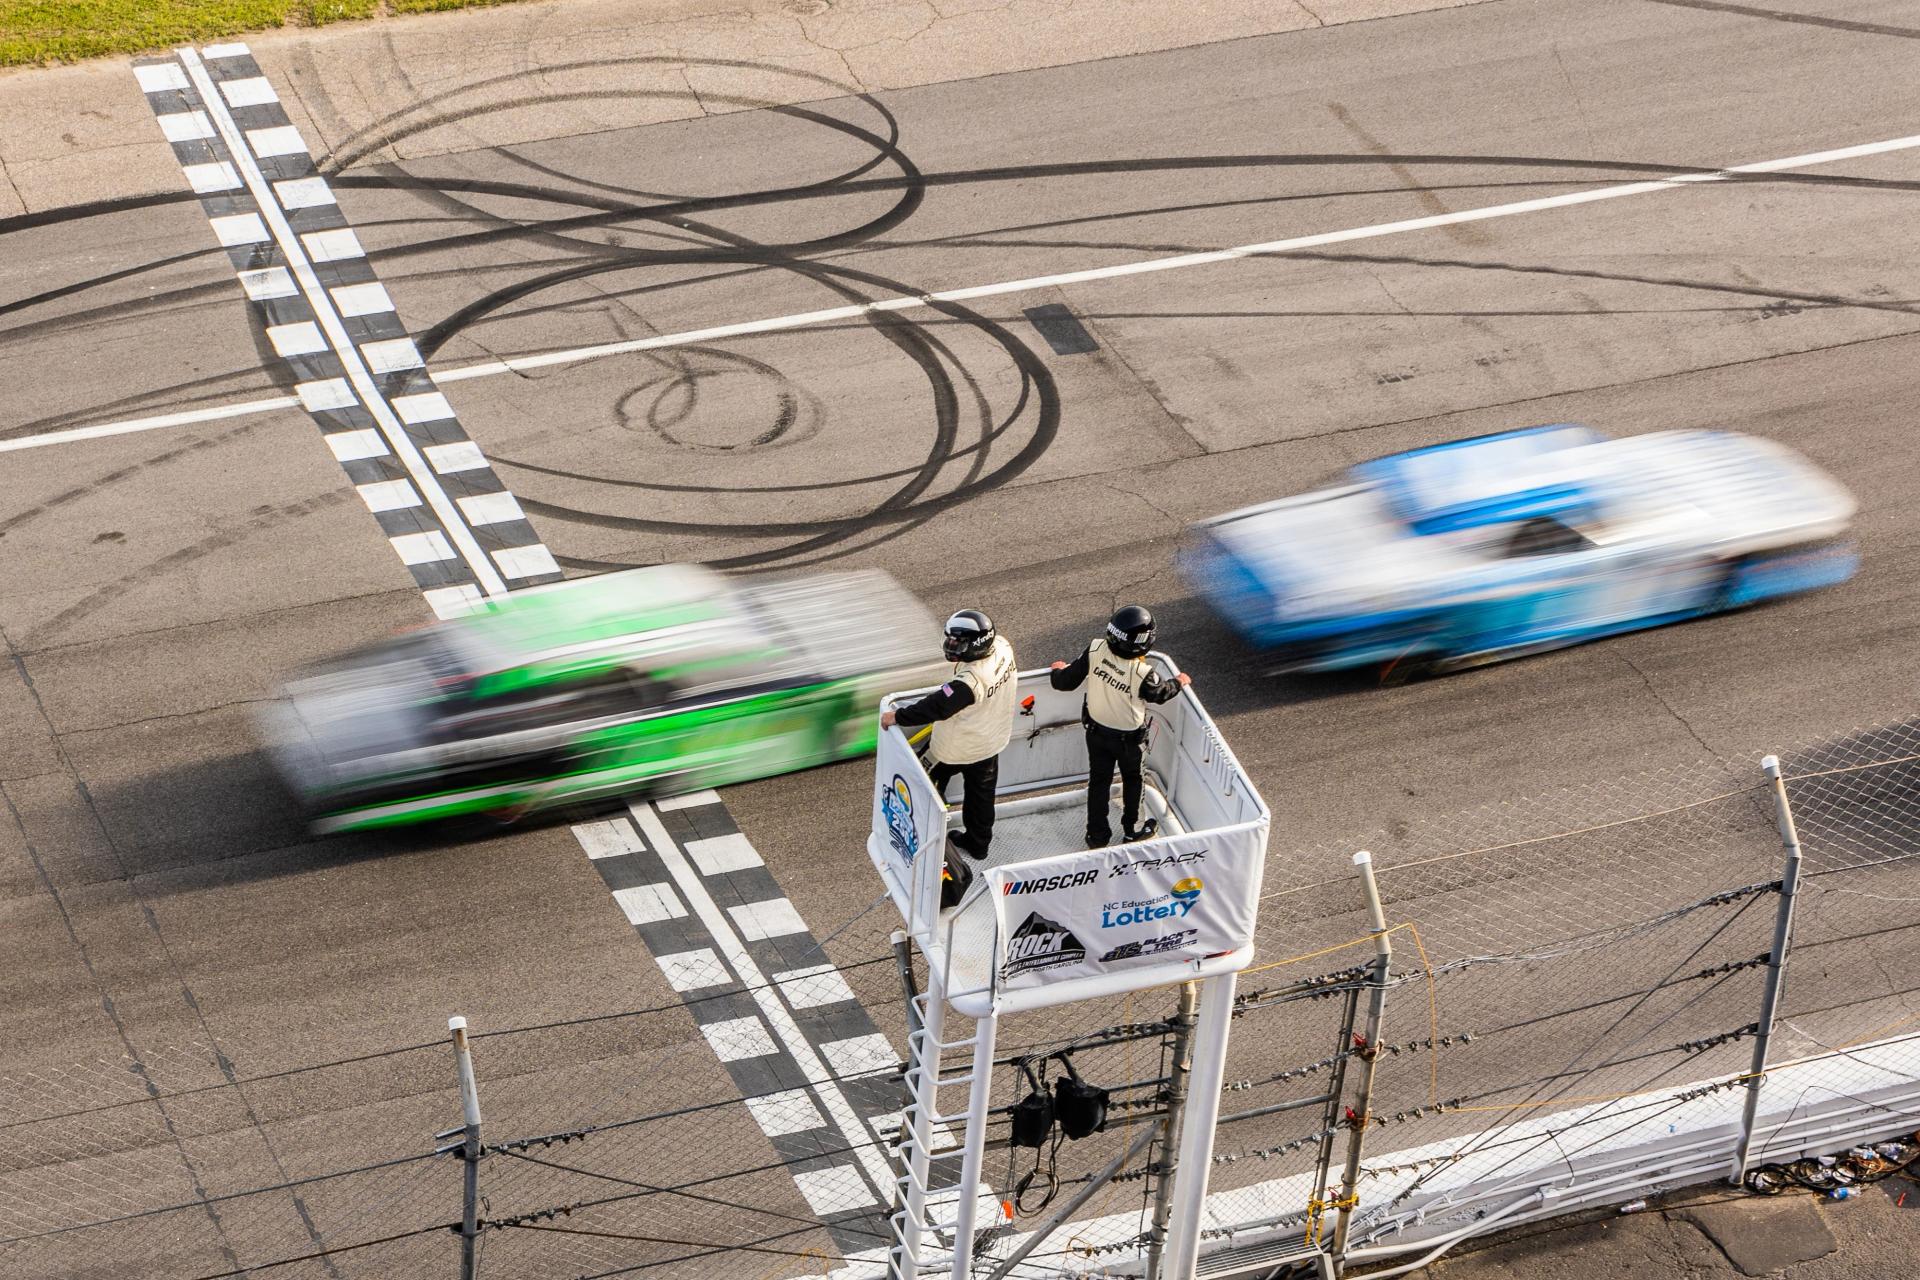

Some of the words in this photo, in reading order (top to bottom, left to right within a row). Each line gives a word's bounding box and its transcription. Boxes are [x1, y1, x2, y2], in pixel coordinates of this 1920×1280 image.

[1093, 666, 1131, 694] OFFICIAL
[1131, 849, 1208, 871] TRACK
[1018, 869, 1100, 895] NASCAR
[1101, 900, 1198, 929] Lottery
[1103, 902, 1119, 911] NC
[1121, 894, 1169, 909] Education
[1007, 931, 1071, 963] ROCK
